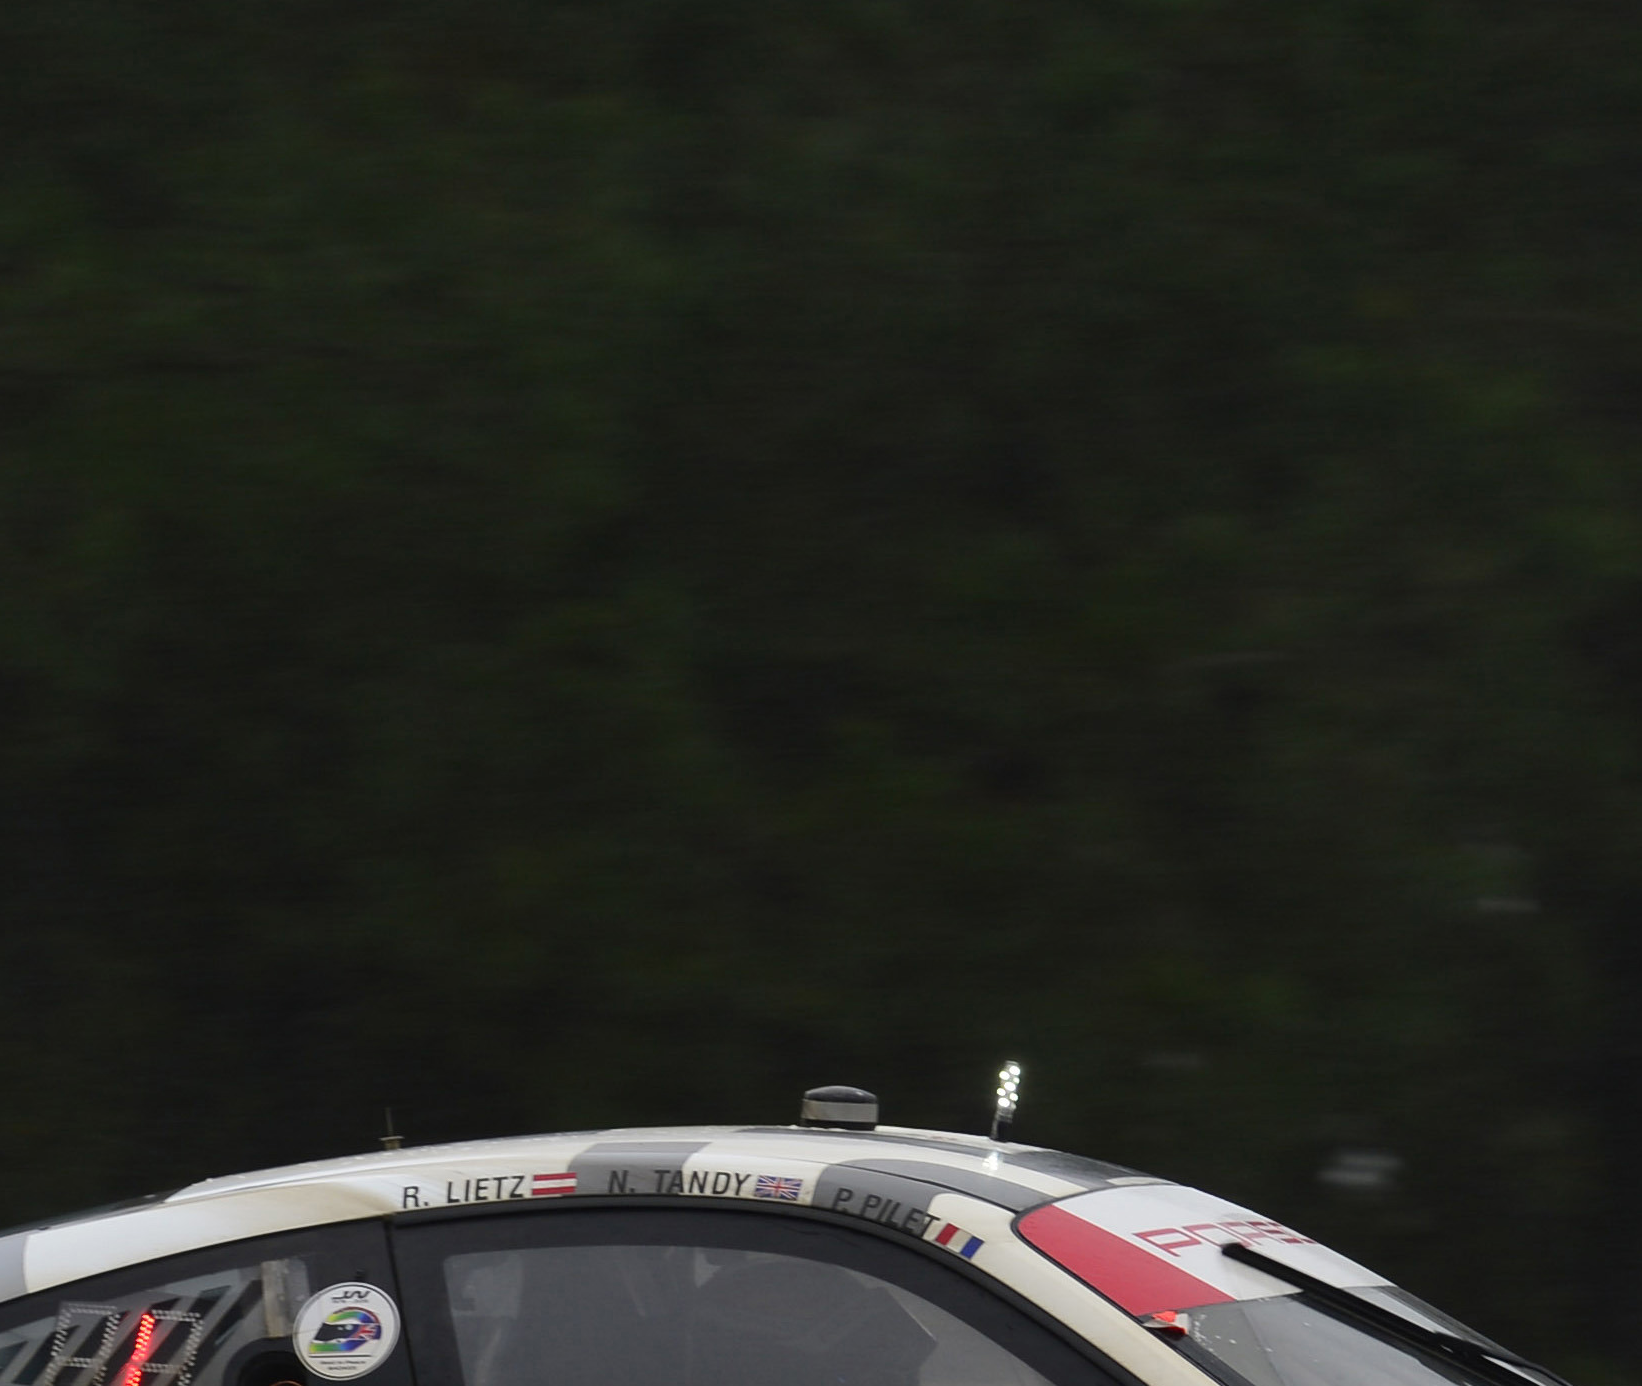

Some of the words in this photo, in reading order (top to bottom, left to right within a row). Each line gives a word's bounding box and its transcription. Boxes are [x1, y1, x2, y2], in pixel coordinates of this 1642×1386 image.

[403, 1186, 429, 1208] R.
[447, 1175, 525, 1204] LIETZ
[609, 1170, 636, 1193] N.
[654, 1170, 752, 1196] TANDY
[832, 1187, 854, 1212] P.
[860, 1194, 941, 1238] PILET
